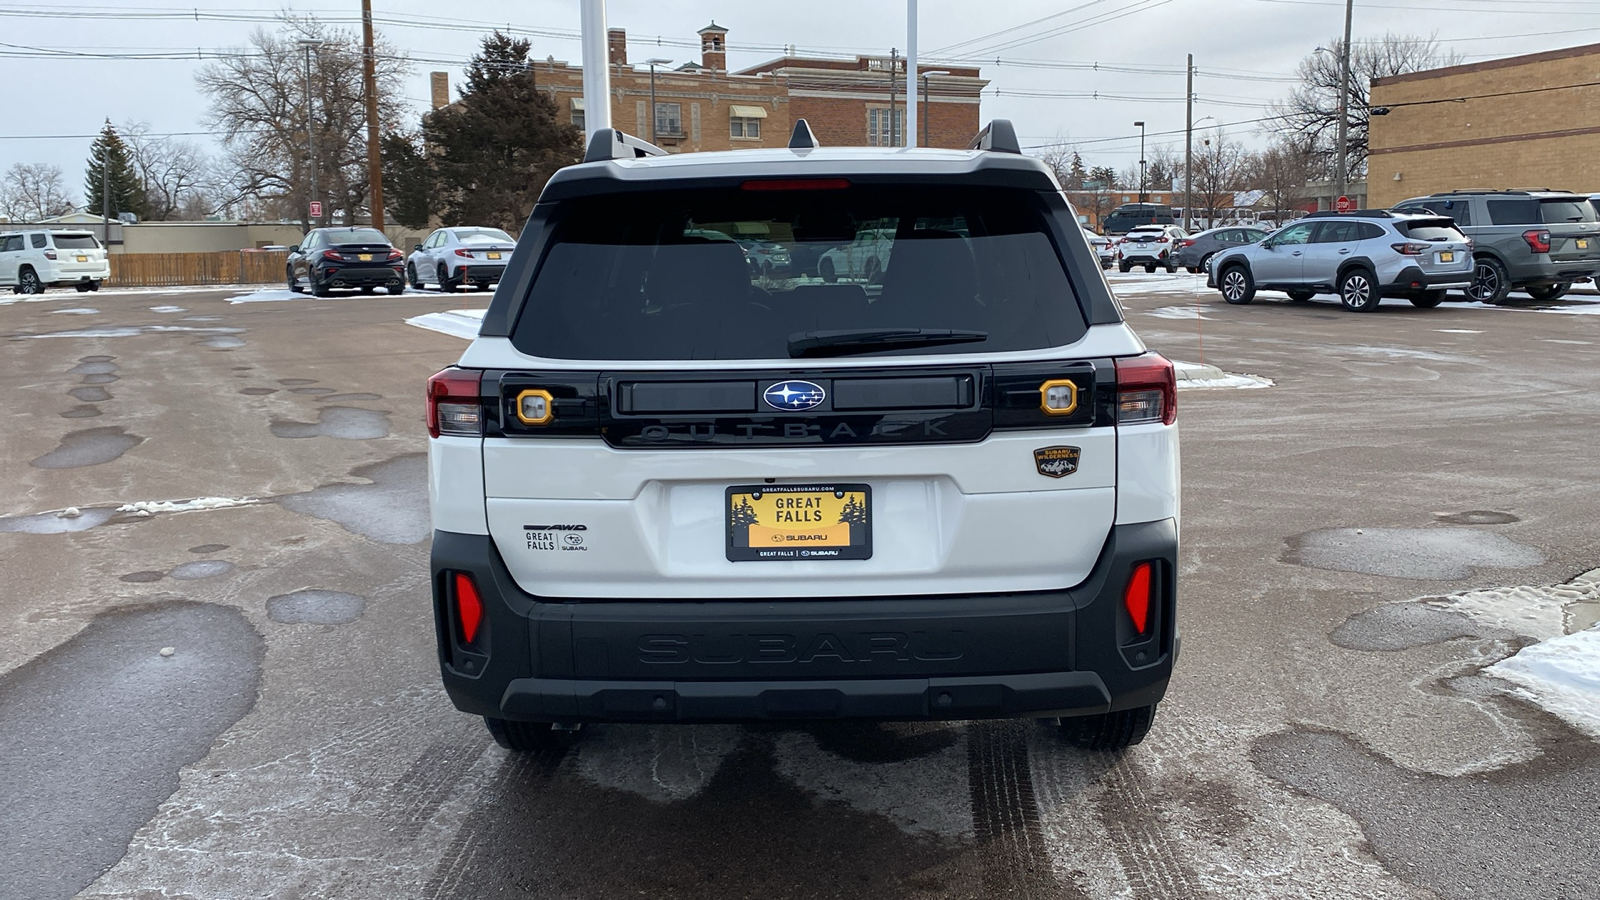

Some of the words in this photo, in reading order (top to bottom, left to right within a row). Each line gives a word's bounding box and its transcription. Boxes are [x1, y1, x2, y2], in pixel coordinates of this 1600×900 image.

[641, 420, 948, 441] OUTBACK
[775, 497, 822, 509] GREAT
[776, 510, 822, 522] FALLS
[526, 532, 553, 541] GREAT
[527, 541, 555, 551] FALLS
[637, 630, 964, 664] SUBARU
